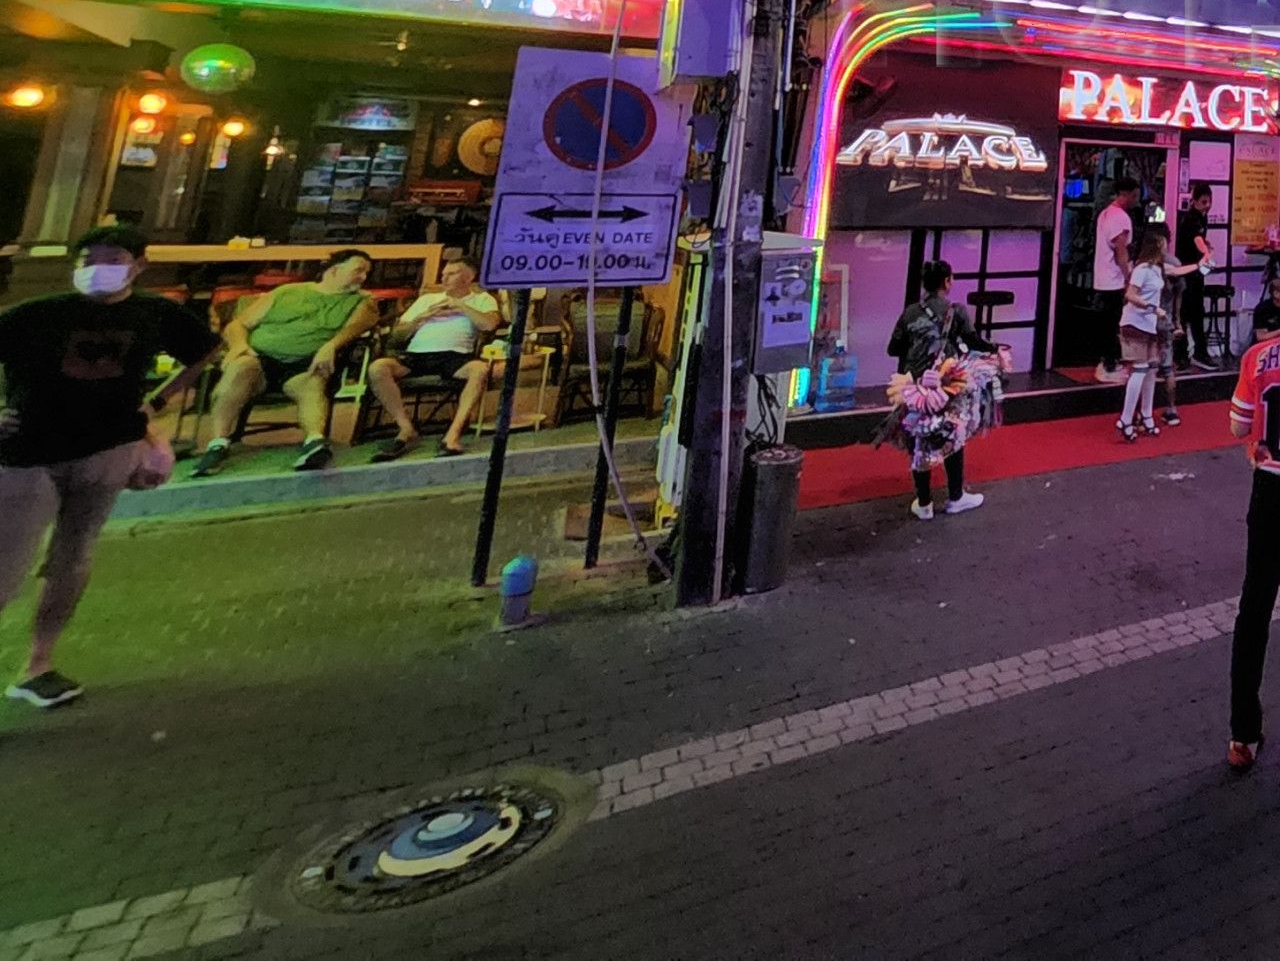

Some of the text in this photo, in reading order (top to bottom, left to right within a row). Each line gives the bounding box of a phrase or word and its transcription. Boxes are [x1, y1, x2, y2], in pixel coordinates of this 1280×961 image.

[1065, 69, 1270, 133] PALACE
[836, 128, 1048, 171] PALACE
[563, 232, 605, 245] EVEN
[612, 232, 654, 245] DATE
